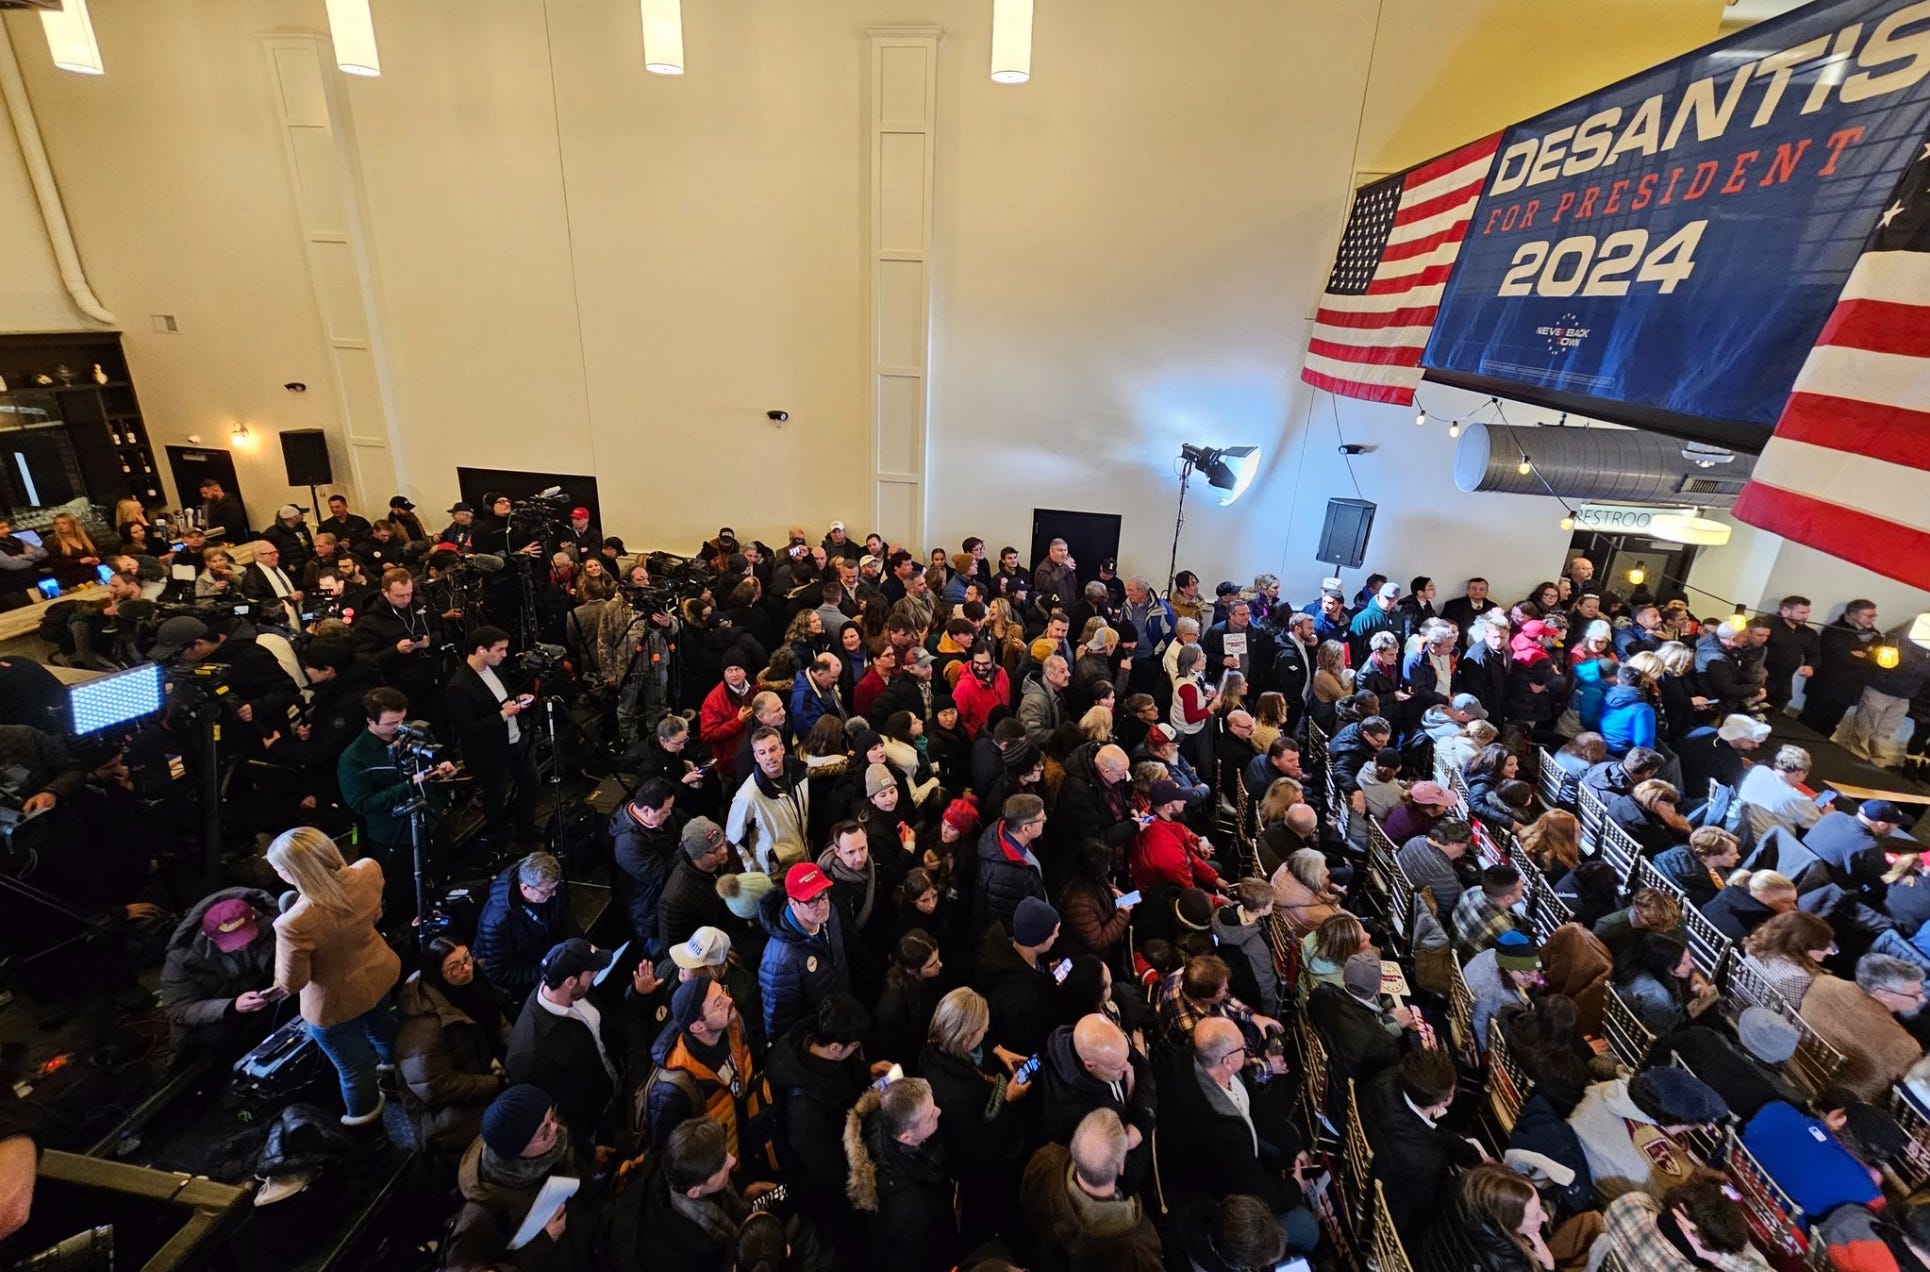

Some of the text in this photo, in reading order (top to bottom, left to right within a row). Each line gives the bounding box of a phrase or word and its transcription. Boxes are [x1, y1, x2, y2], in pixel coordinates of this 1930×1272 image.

[1490, 0, 1930, 196] DESANTIS
[1482, 126, 1866, 235] FOR PRESIDENT
[1497, 220, 1708, 297] 2024
[1565, 328, 1590, 338] BACK
